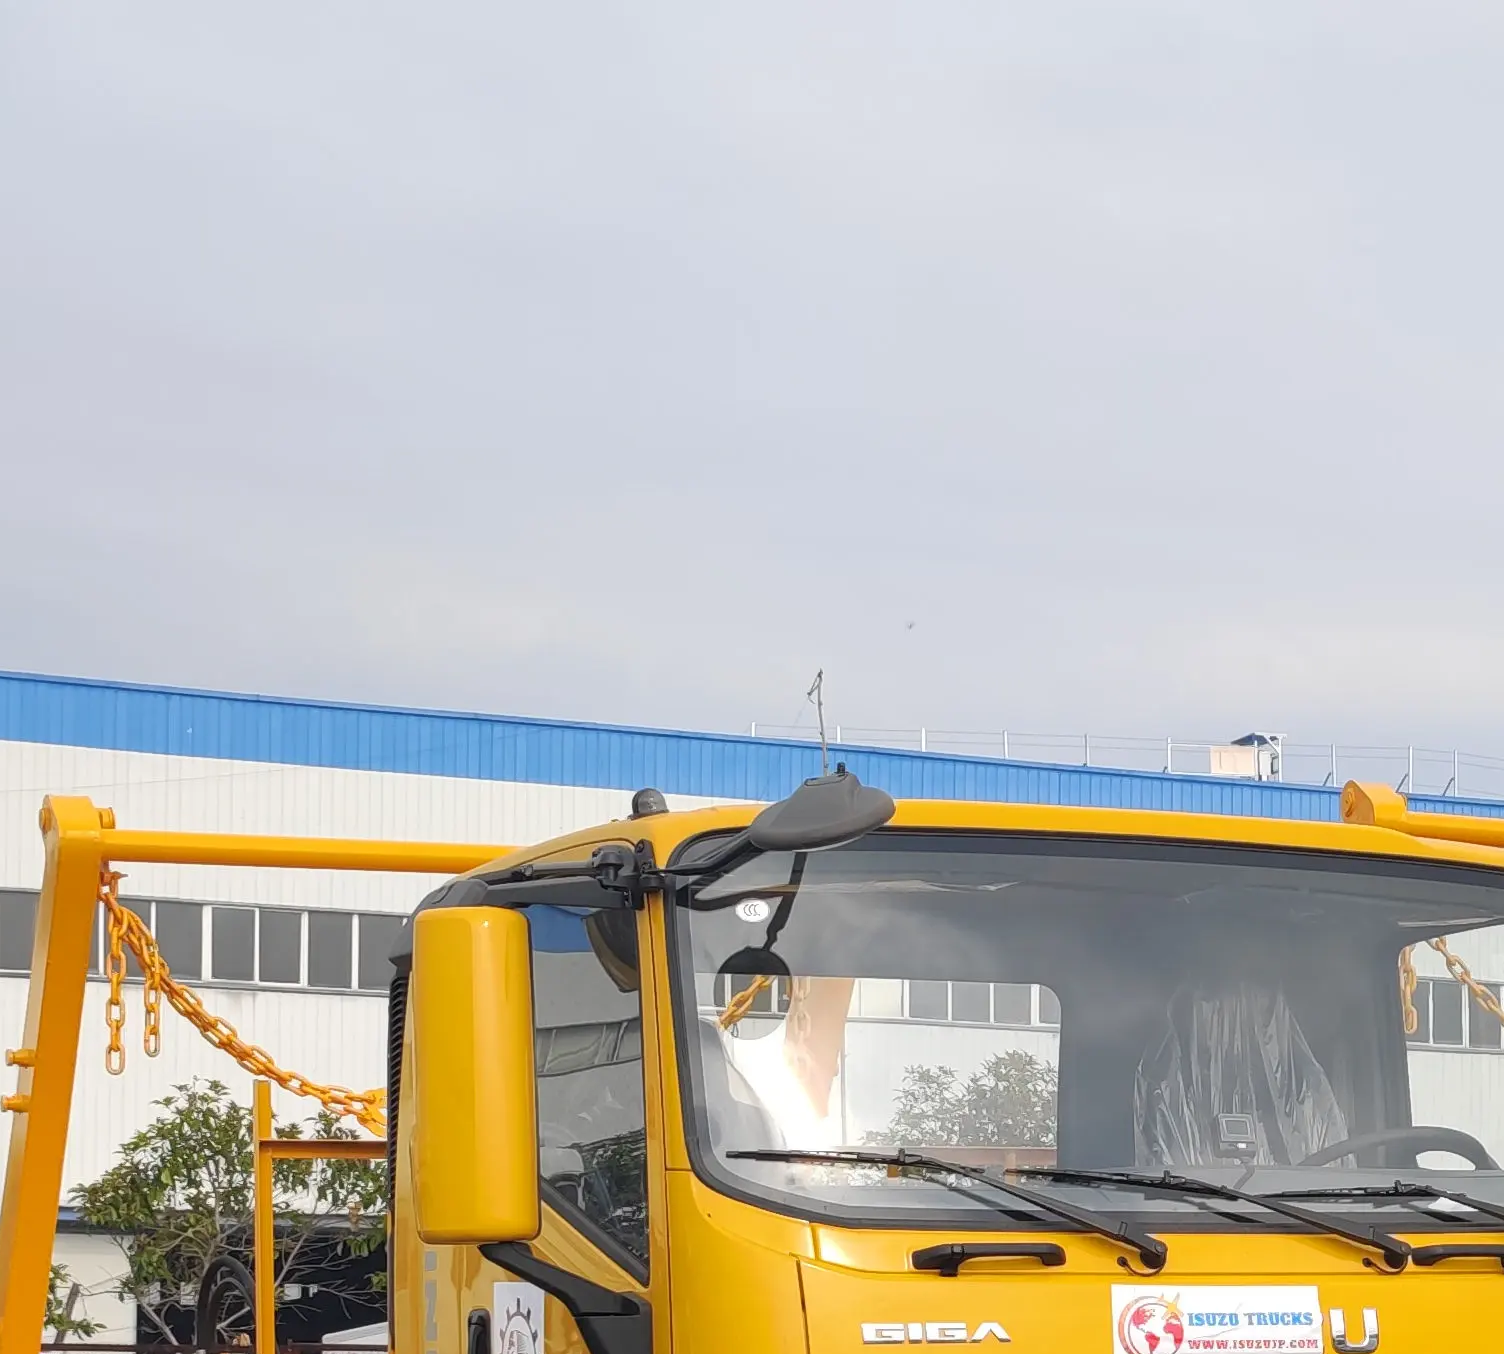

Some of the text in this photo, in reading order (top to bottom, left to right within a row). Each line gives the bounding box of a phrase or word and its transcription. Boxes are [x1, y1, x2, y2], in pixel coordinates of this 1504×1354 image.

[1186, 1311, 1314, 1326] ISUZU TRUCKS
[860, 1321, 1012, 1345] GIGA
[1187, 1339, 1319, 1350] WWW.ISUZUJP.COM
